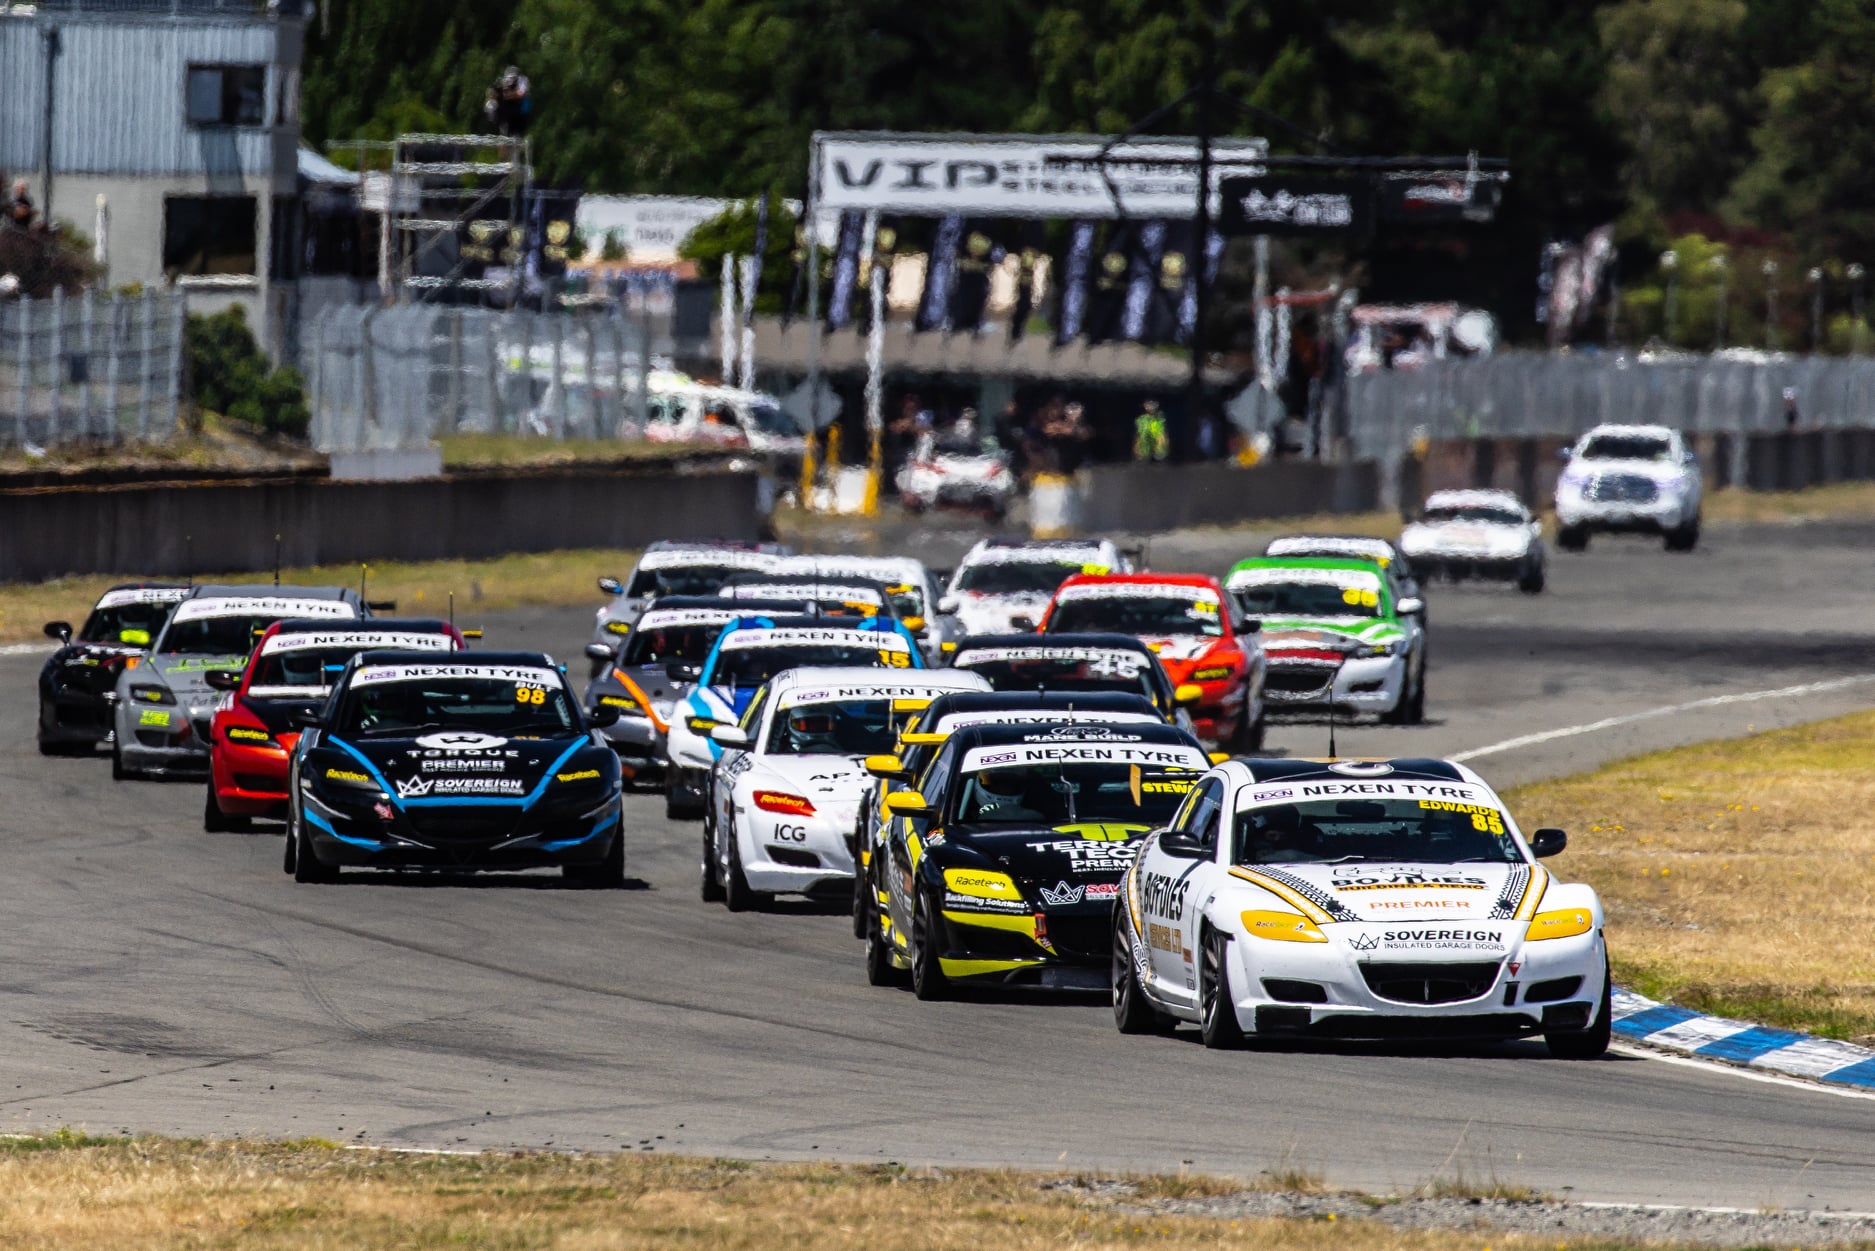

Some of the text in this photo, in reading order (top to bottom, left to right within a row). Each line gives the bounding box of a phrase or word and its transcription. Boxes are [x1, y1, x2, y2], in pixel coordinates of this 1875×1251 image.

[833, 157, 998, 190] VIP
[314, 635, 382, 643] NEXEN
[391, 636, 443, 647] TYRE
[770, 631, 835, 641] NEXEN
[844, 632, 894, 645] TYRE
[878, 648, 910, 669] 15
[405, 667, 478, 676] NEXEN
[488, 668, 544, 680] TYRE
[516, 687, 546, 705] 98
[838, 687, 914, 696] NEXEN
[1026, 748, 1111, 760] NEXEN
[1119, 749, 1190, 765] TYRE
[422, 759, 506, 768] PREMIER
[434, 779, 522, 788] SOVEREIGN
[1303, 784, 1394, 796] NEXEN
[1401, 784, 1474, 801] TYRE
[1418, 799, 1500, 818] EDWARDS
[1470, 813, 1504, 835] 85
[774, 823, 806, 842] ICG
[1060, 848, 1137, 859] TEC
[1071, 859, 1133, 868] PREM
[955, 876, 1006, 888] Racetech
[1086, 883, 1120, 893] SOV
[1144, 872, 1190, 921] BOYDIES
[985, 898, 1025, 909] Solutions
[1369, 900, 1471, 909] PREMIER
[1384, 930, 1502, 942] SOVEREIGN
[1475, 943, 1505, 951] DOORS
